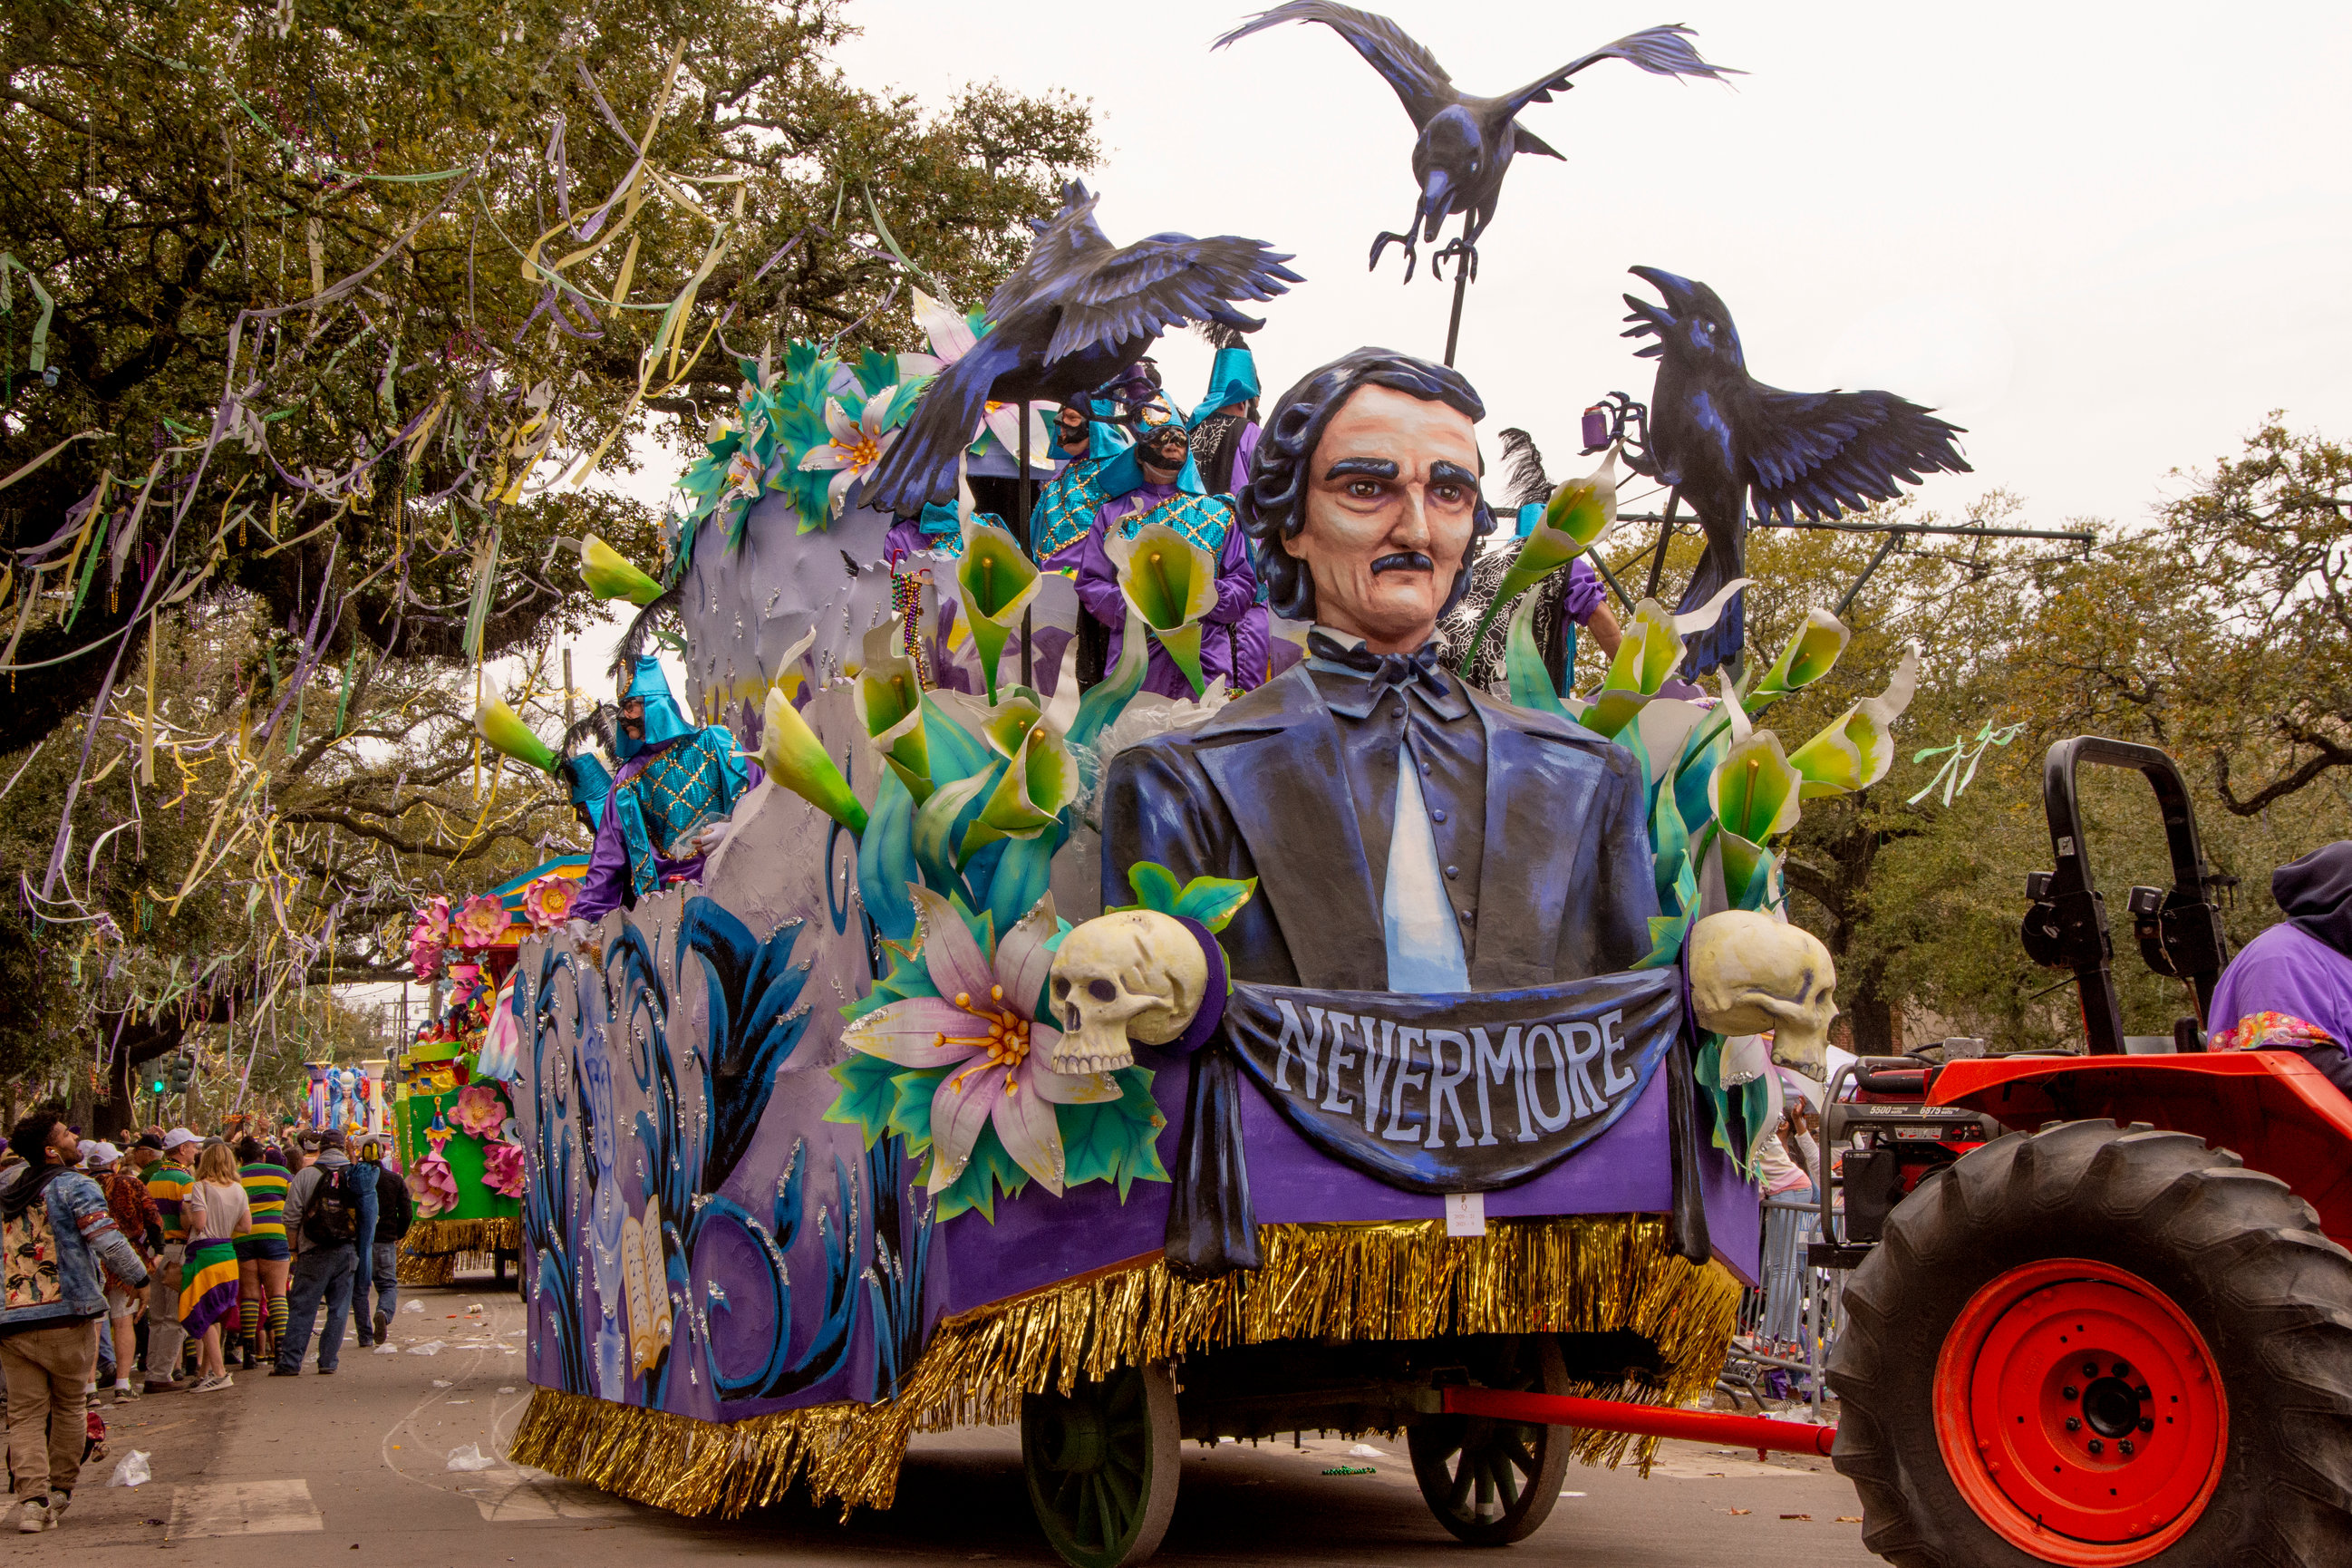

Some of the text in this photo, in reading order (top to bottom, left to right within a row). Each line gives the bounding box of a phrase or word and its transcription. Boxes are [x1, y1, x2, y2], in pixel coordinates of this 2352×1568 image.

[1273, 998, 1636, 1149] NEVERMORE
[1870, 1107, 1892, 1115] 5500
[1920, 1107, 1941, 1115] 6875
